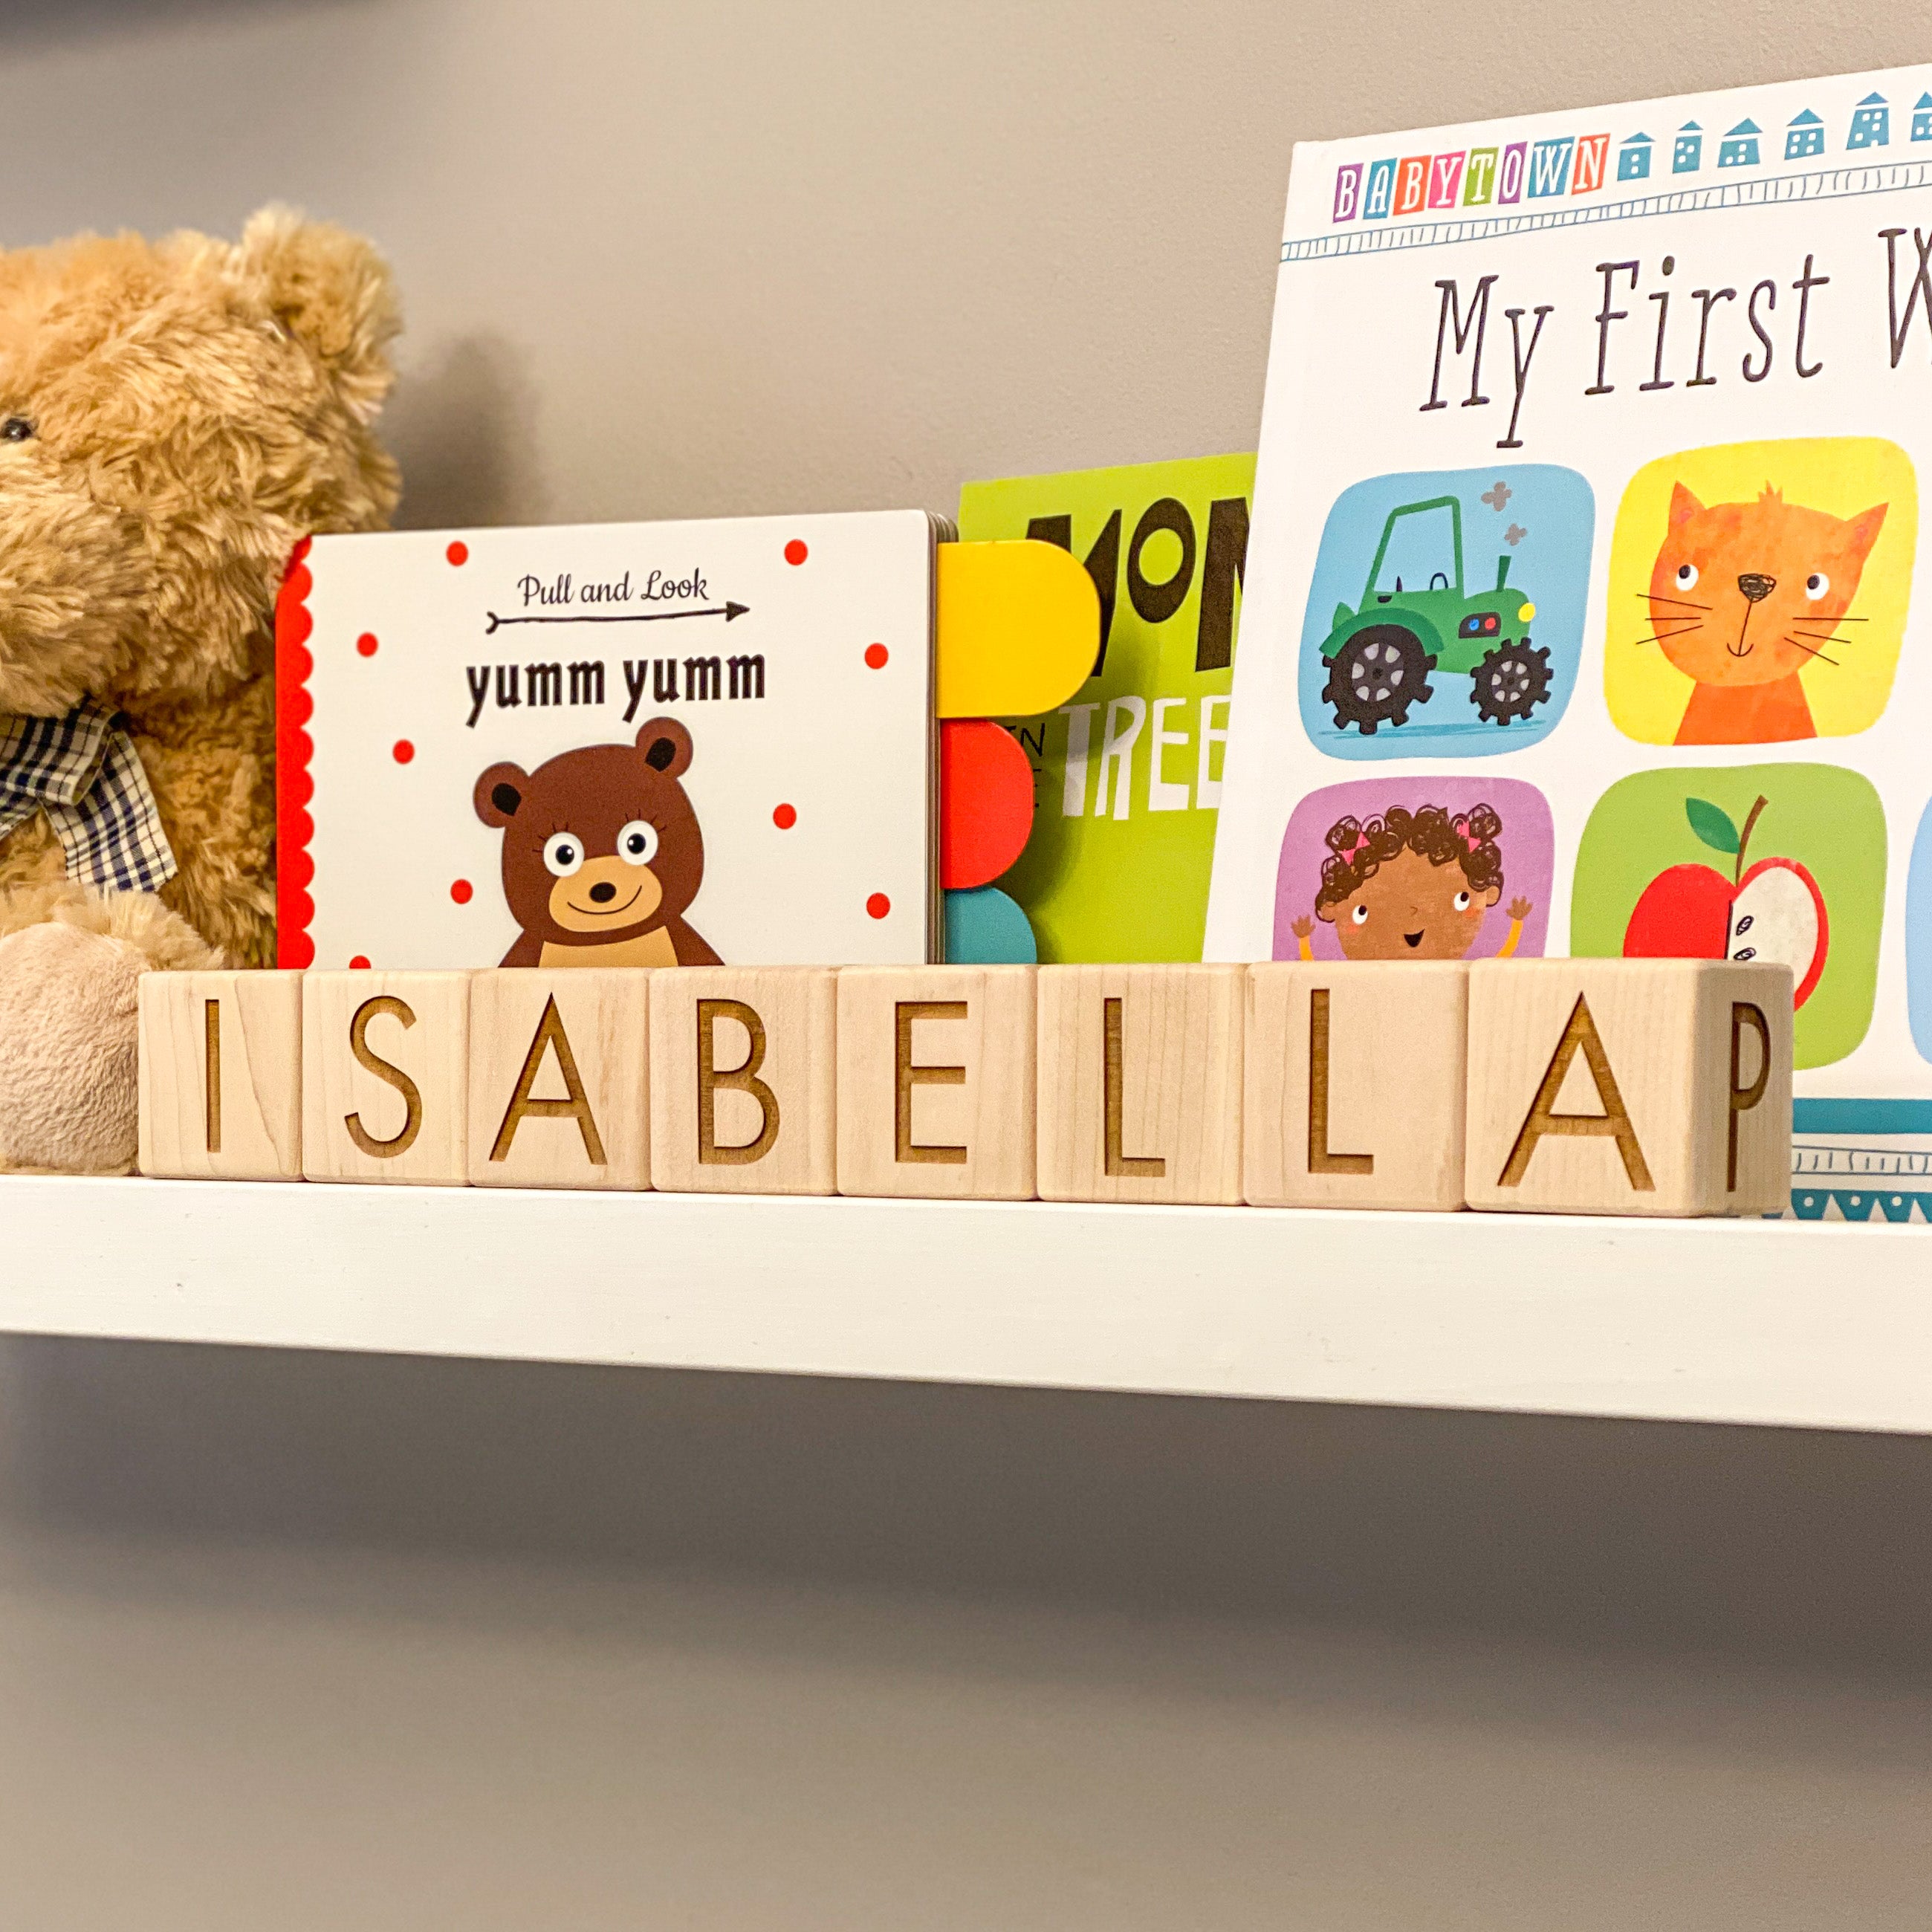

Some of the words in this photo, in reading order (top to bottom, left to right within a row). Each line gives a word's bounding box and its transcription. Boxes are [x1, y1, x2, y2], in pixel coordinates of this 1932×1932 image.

[1334, 134, 1609, 222] BABYTOWN
[1419, 273, 1555, 449] My
[1584, 254, 1830, 395] First
[517, 573, 574, 606] Pull
[580, 571, 633, 603] and
[640, 567, 710, 601] Look
[465, 660, 606, 729] yumm
[622, 654, 766, 724] yumm
[1057, 695, 1231, 821] TREE
